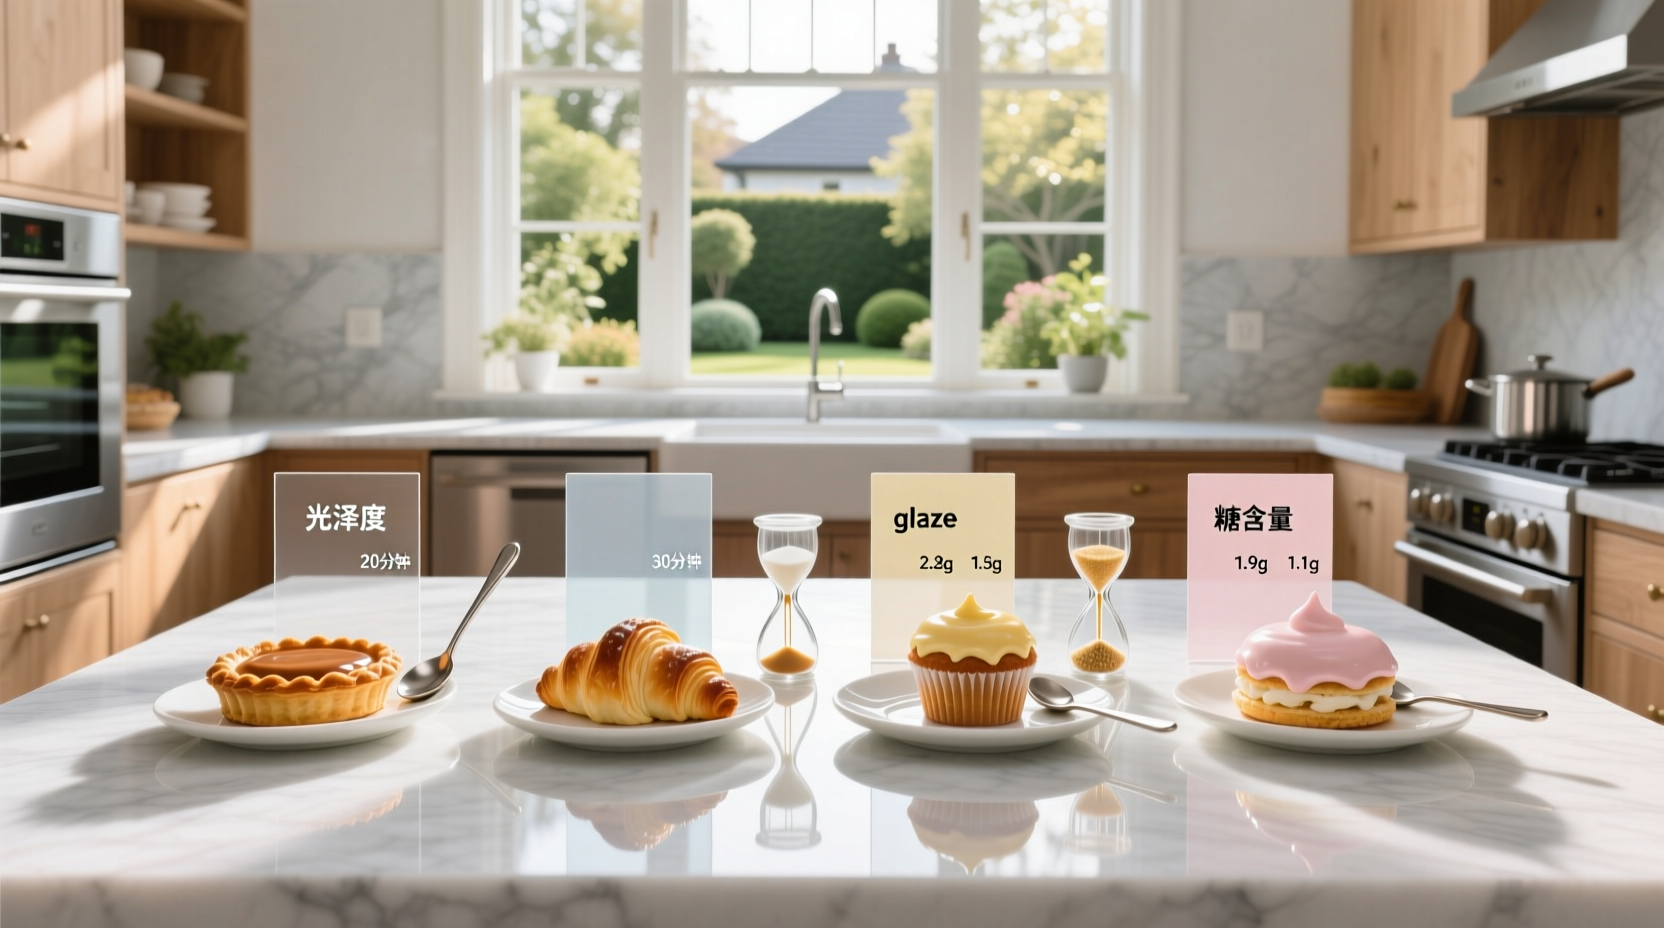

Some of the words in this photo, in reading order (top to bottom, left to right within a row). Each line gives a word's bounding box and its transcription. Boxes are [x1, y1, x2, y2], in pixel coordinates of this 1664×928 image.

[306, 503, 386, 532] 光泽度
[894, 506, 957, 534] glaze
[1214, 504, 1293, 532] 糖含量
[971, 555, 1002, 574] 1.5g
[1235, 555, 1268, 575] 1.9g
[1288, 555, 1319, 575] 1.1g
